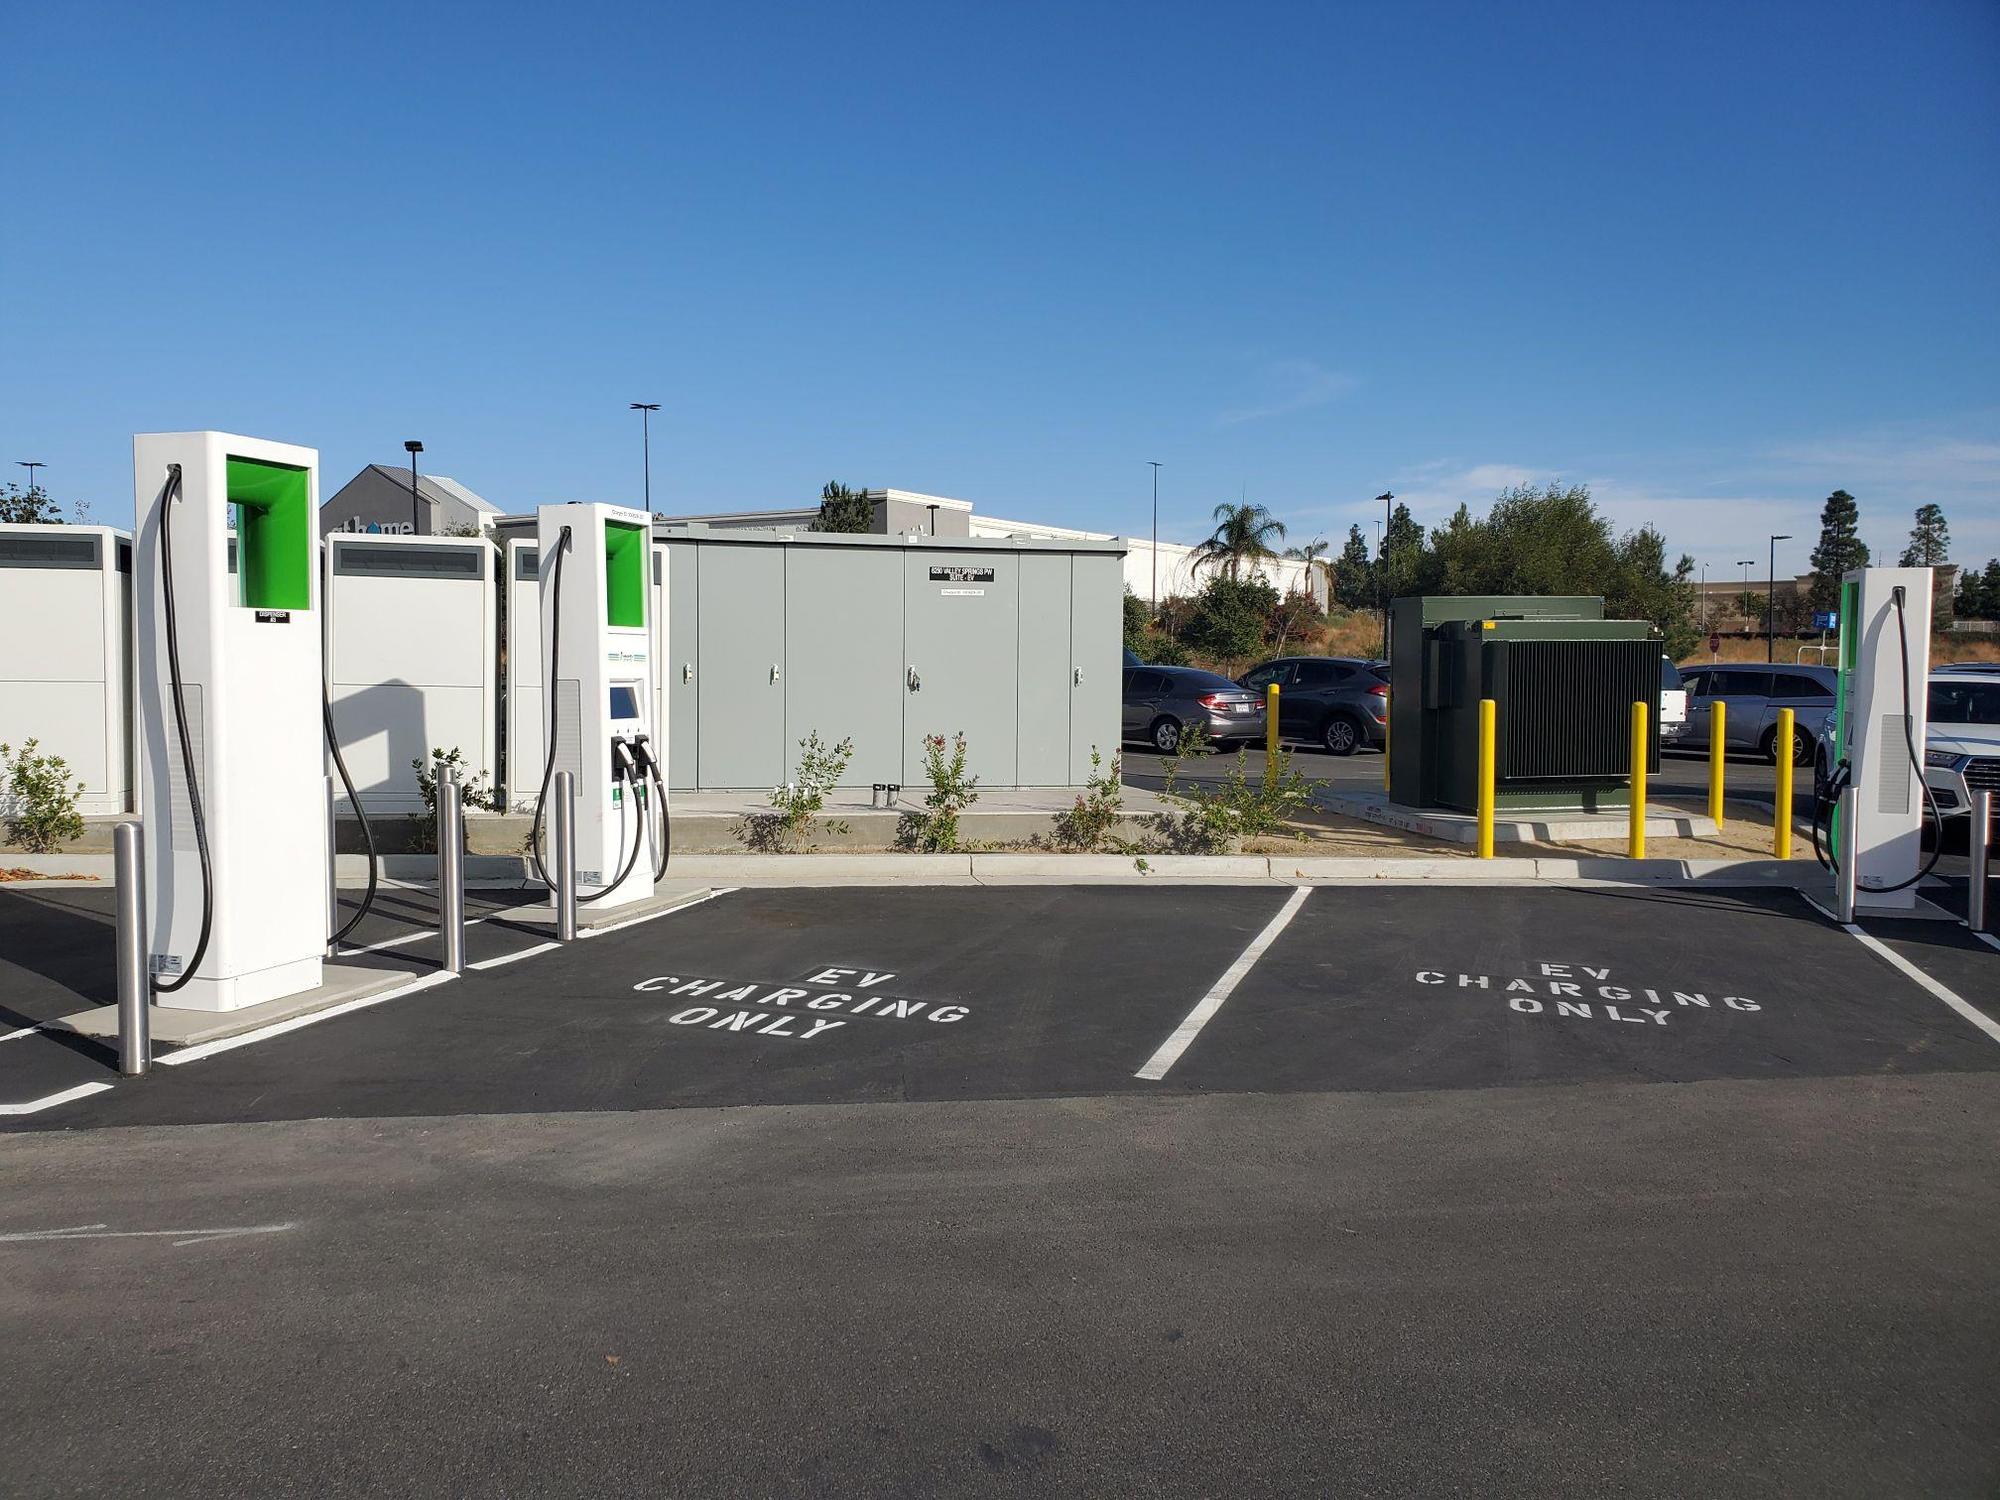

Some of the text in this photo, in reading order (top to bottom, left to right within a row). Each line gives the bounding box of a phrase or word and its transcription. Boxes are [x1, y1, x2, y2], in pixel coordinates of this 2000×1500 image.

[962, 567, 984, 575] SPRINGS
[806, 968, 896, 988] EV
[1540, 963, 1610, 980] EV
[633, 976, 970, 1023] CHARGING
[1415, 971, 1762, 1012] CHARGING
[669, 1007, 847, 1039] ONLY
[1509, 998, 1672, 1026] ONLY
